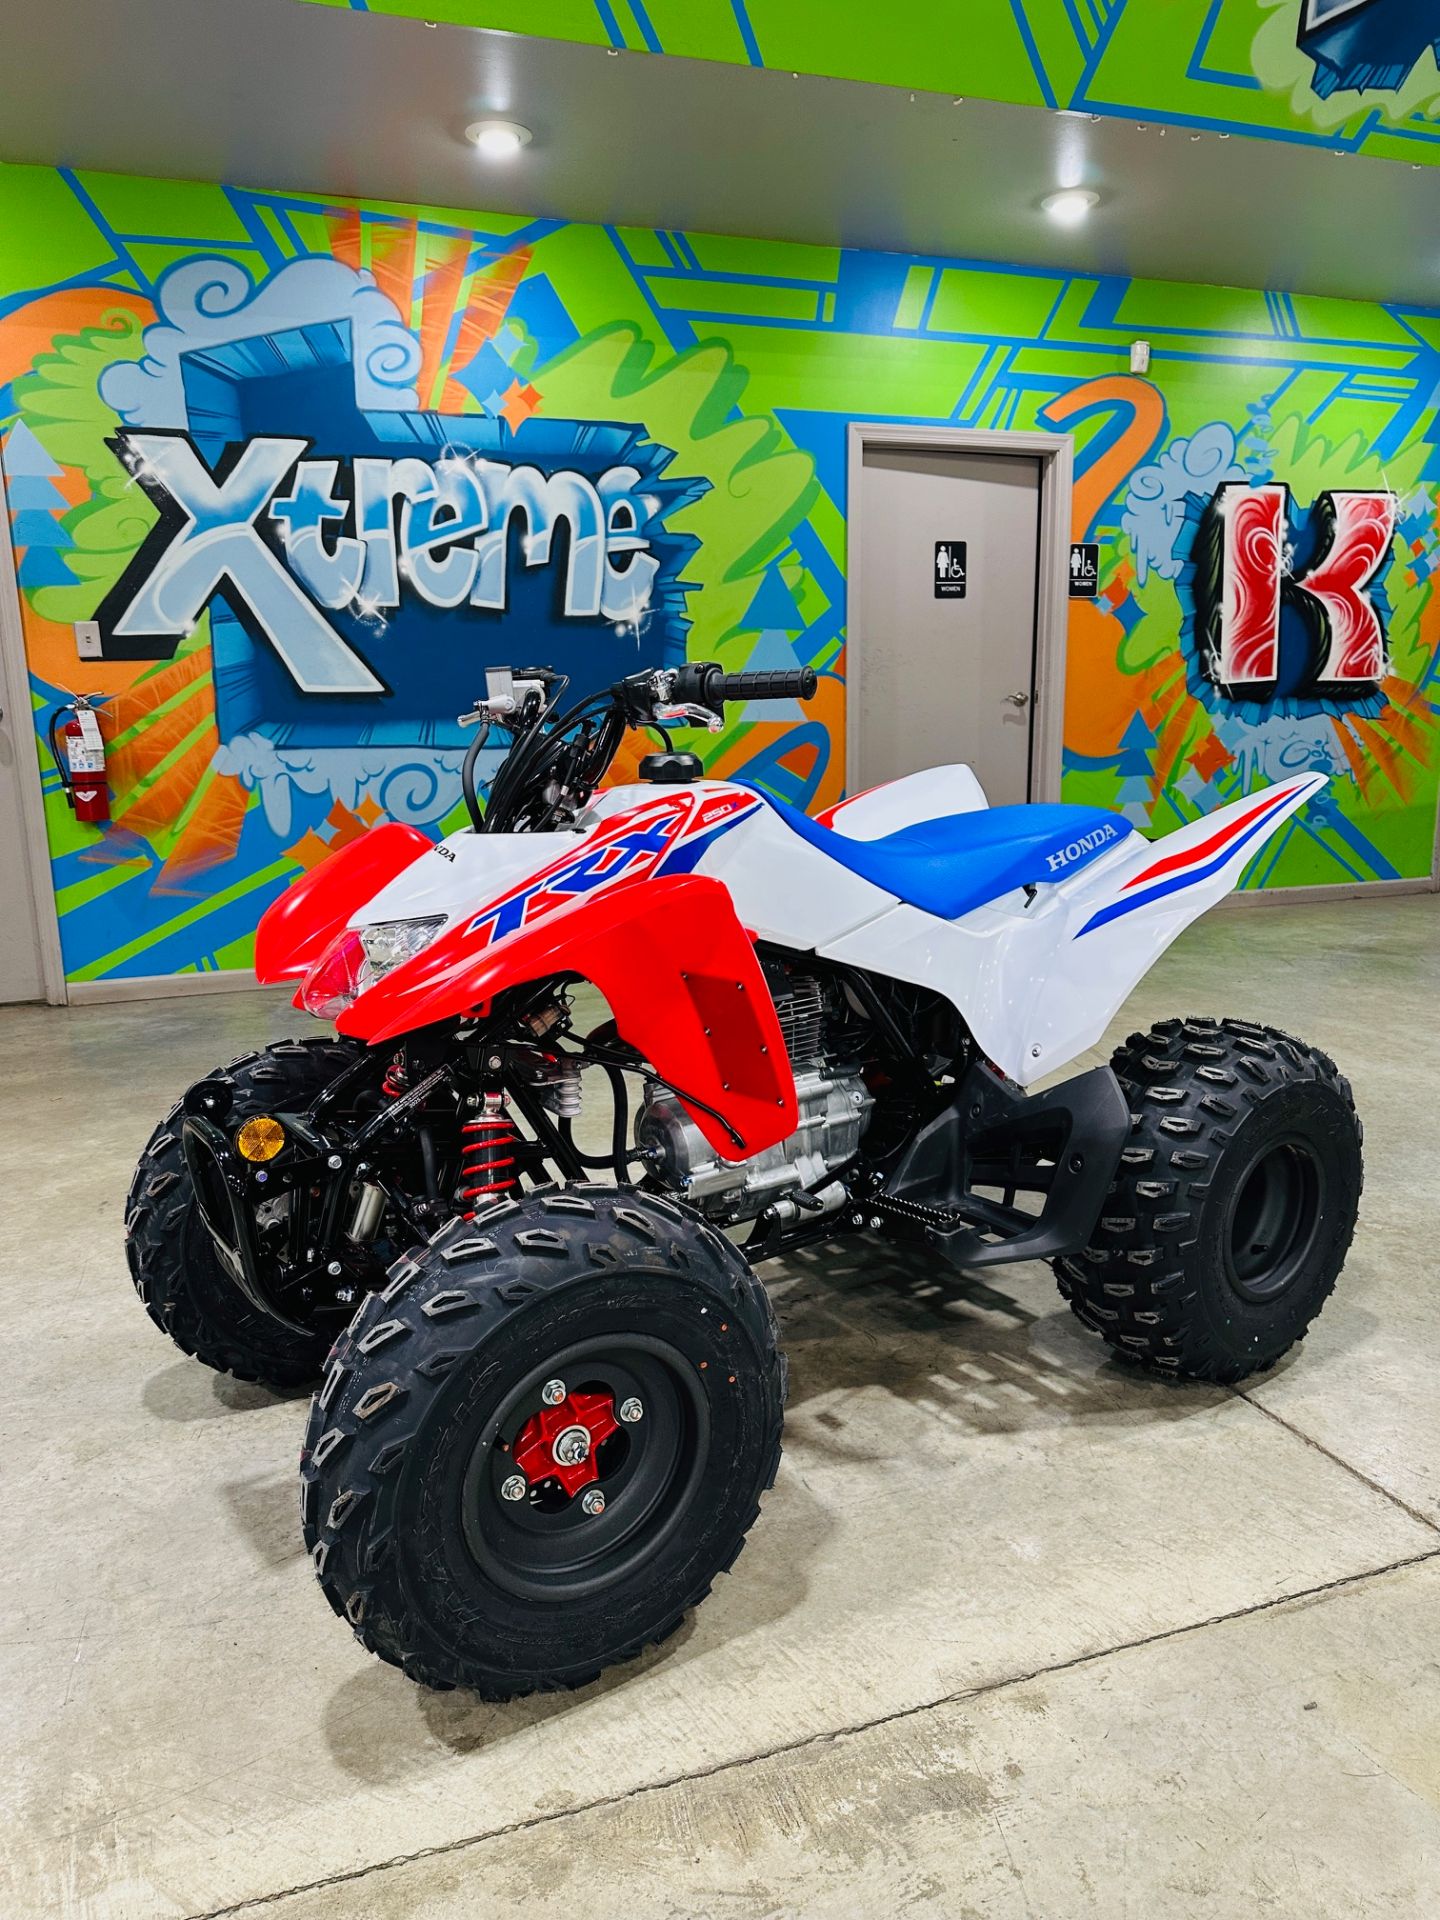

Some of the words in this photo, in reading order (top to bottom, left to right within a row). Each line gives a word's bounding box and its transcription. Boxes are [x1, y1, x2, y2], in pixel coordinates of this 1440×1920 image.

[104, 430, 662, 694] Xtreme
[1219, 484, 1396, 685] K
[467, 811, 681, 944] TRX
[1045, 824, 1118, 872] HONDA
